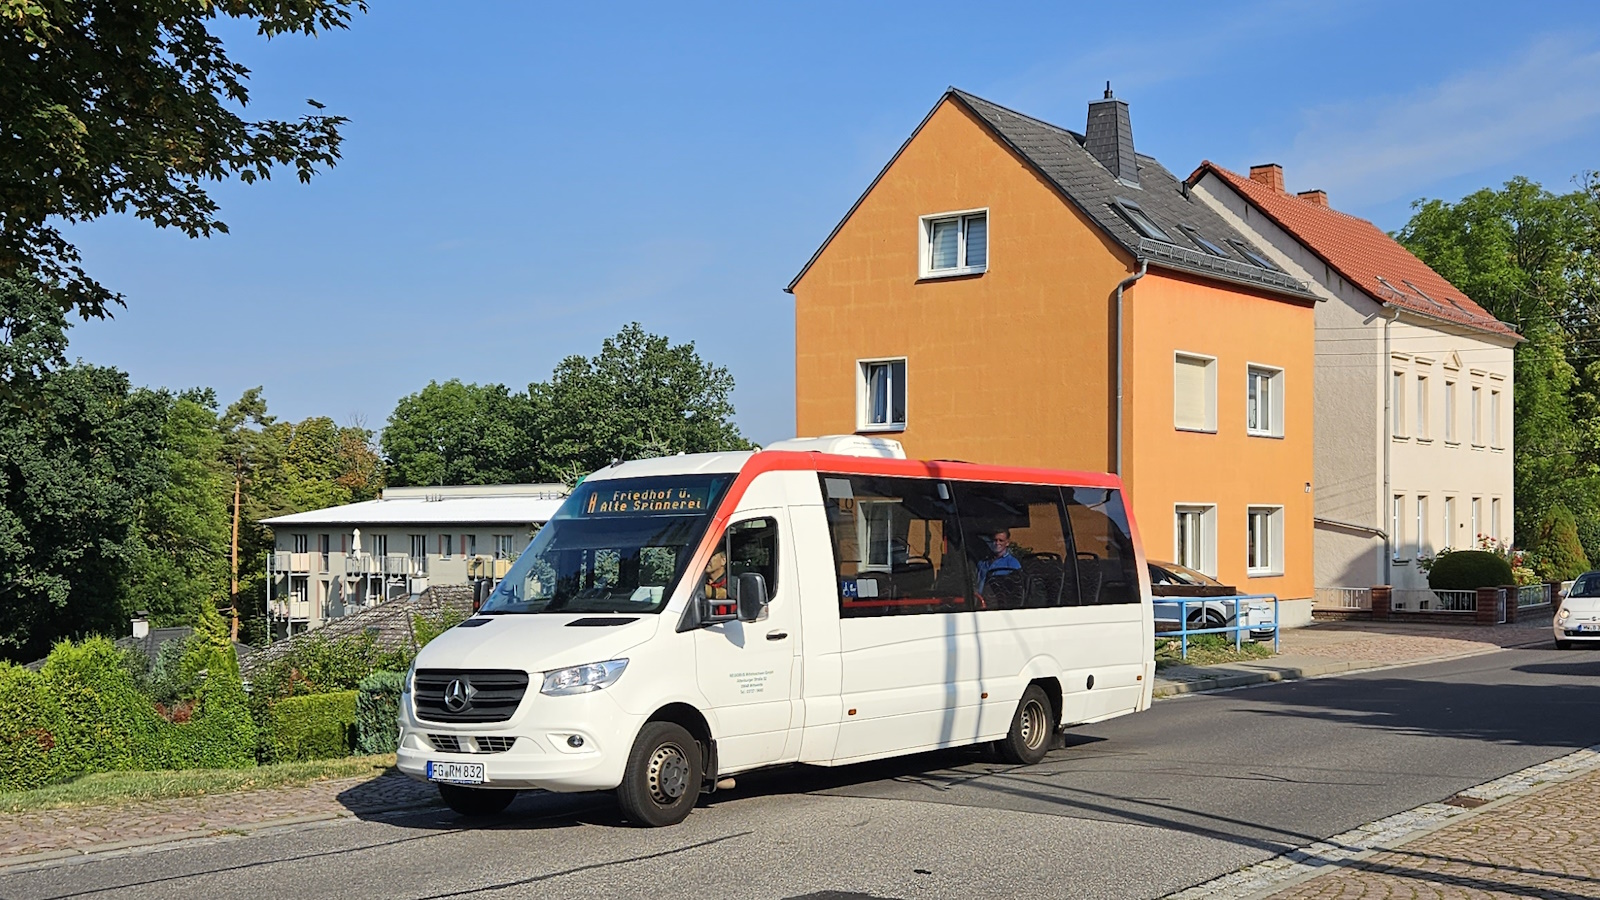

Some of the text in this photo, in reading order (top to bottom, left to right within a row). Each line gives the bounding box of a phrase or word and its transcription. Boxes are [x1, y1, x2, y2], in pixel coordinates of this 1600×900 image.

[613, 488, 673, 501] Friedhof
[600, 497, 702, 512] Alte Spinnerei
[433, 764, 482, 778] FG RM 832
